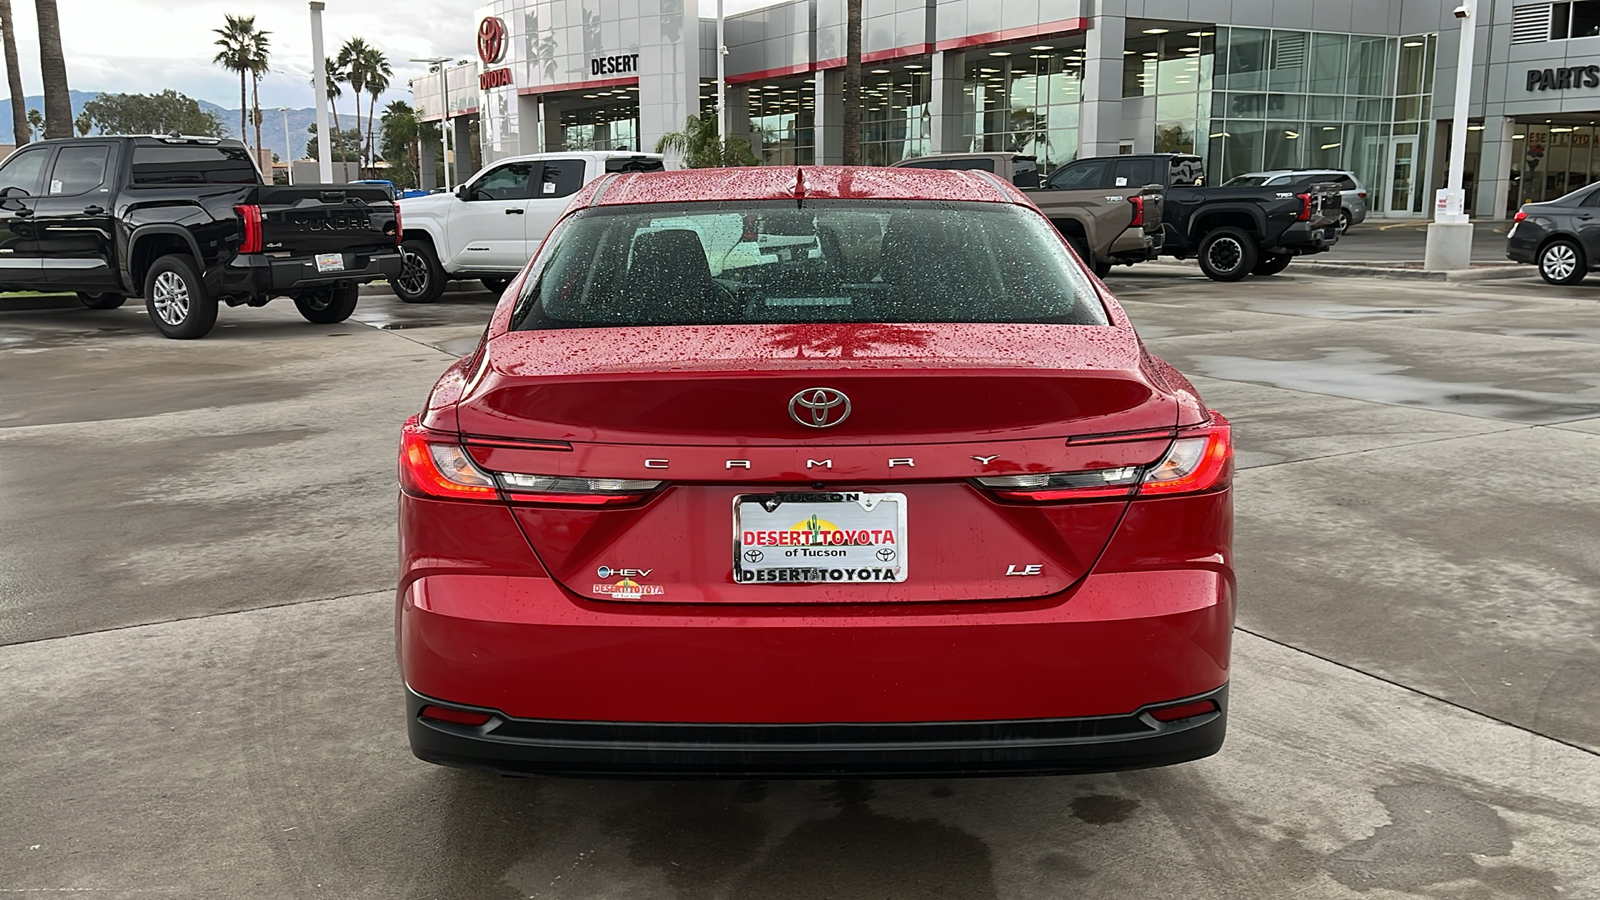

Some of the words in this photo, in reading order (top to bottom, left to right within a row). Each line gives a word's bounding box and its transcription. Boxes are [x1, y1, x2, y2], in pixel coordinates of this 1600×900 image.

[591, 54, 639, 75] DESERT
[479, 68, 511, 90] TOYOTA
[1526, 65, 1600, 92] PARTS
[295, 219, 371, 232] TUNDRA
[644, 454, 1001, 469] CAMRY
[783, 493, 860, 502] TUCSON
[743, 530, 813, 546] DESERT
[820, 530, 895, 545] TOYOTA
[785, 548, 798, 557] of
[803, 549, 847, 557] Tucson
[610, 568, 653, 577] HEV
[743, 568, 811, 582] DESERT
[820, 568, 896, 581] TOYOTA
[1005, 564, 1043, 576] LE
[594, 584, 625, 593] DESERT
[629, 585, 664, 594] TOYOTA
